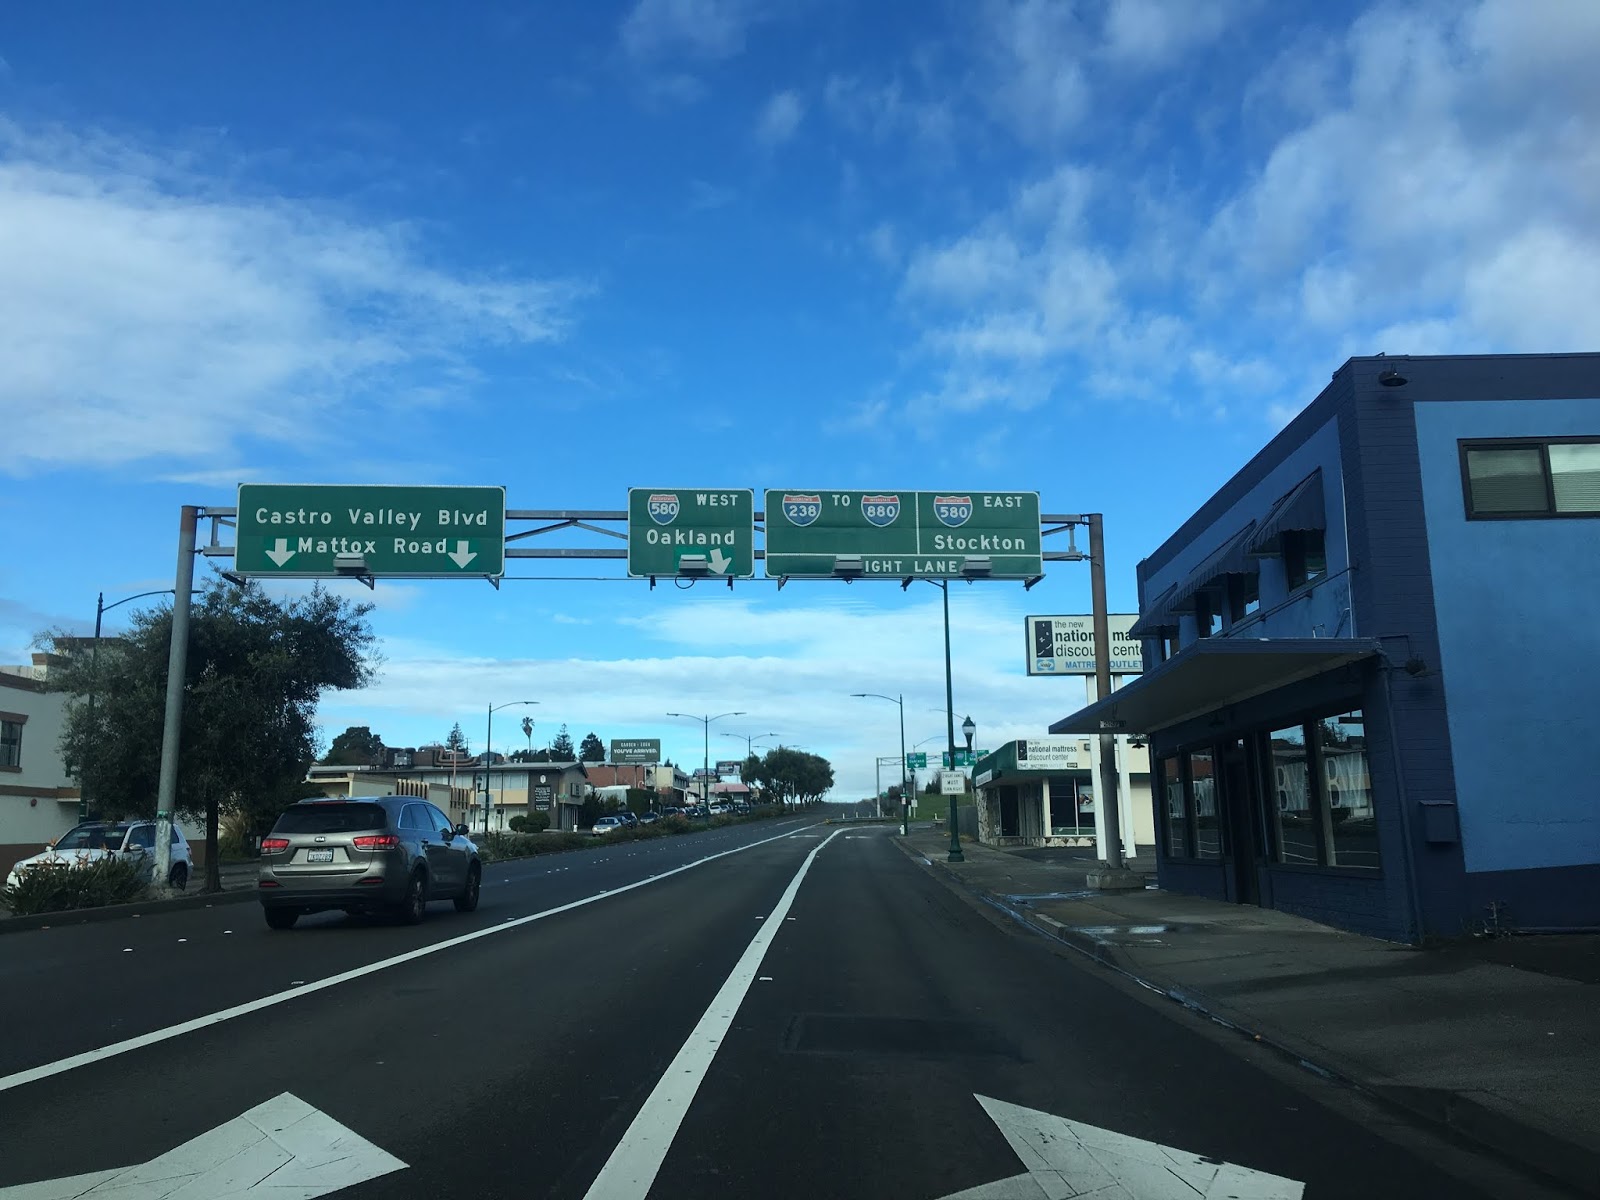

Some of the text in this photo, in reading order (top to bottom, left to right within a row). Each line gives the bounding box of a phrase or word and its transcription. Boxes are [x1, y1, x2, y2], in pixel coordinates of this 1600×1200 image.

[651, 493, 738, 515] 580 WEST
[789, 494, 895, 517] 238 TO 880
[940, 496, 1023, 518] 580 EAST
[255, 507, 487, 531] Castro Valley Blvd
[298, 536, 447, 554] Mattox Road
[646, 529, 735, 545] Oakland
[934, 534, 1025, 550] Stockton
[865, 560, 957, 573] IGHT LANE
[1054, 620, 1067, 628] the
[1055, 629, 1096, 642] nation
[1055, 643, 1142, 657] discou cent
[1065, 660, 1096, 669] MATTRE
